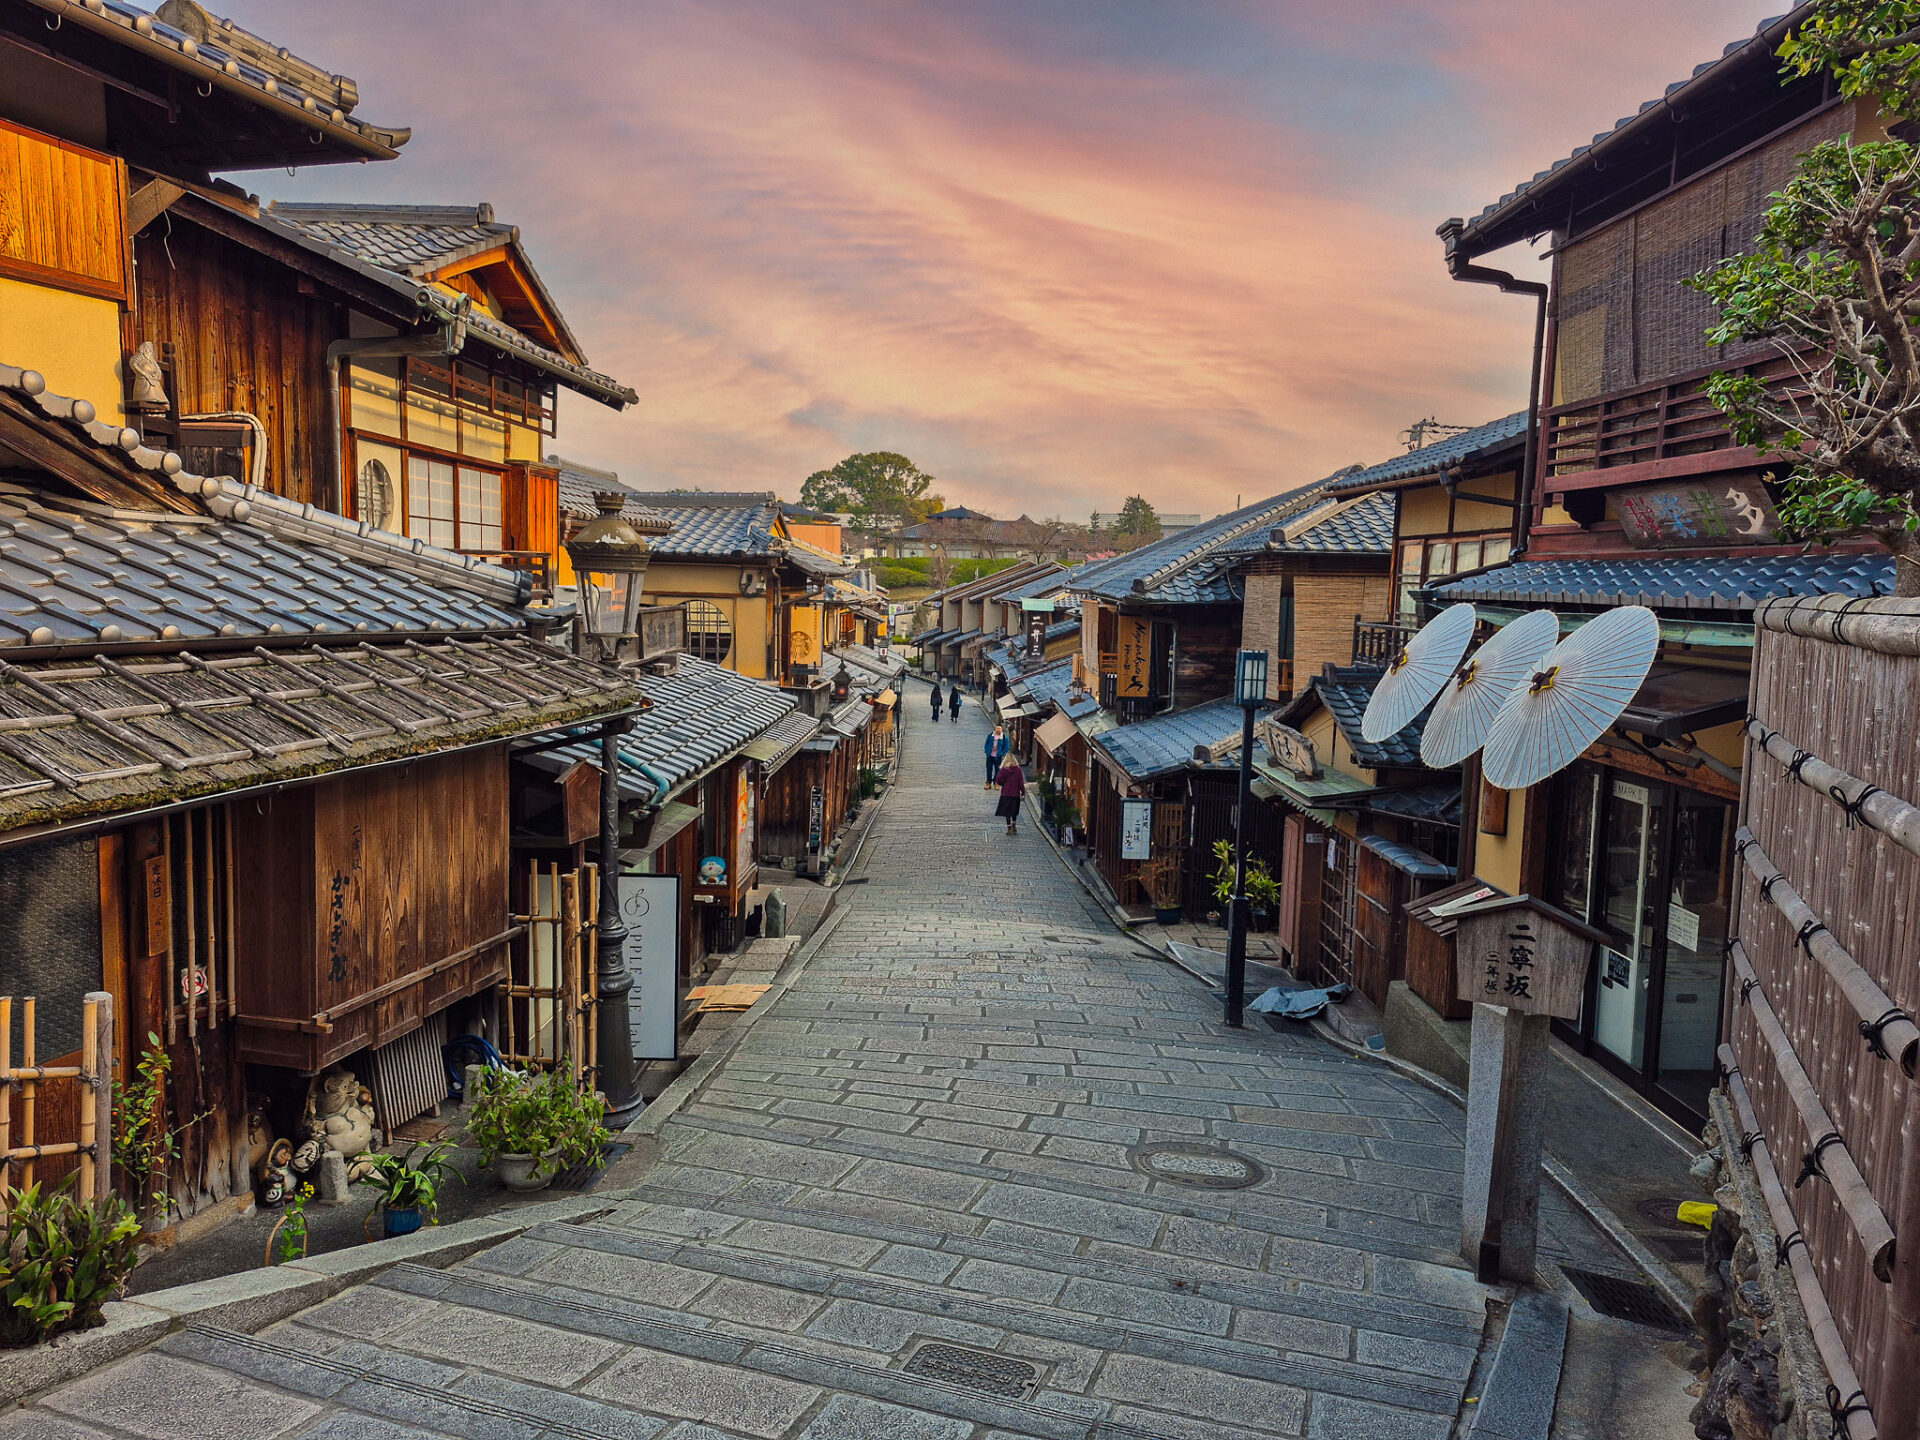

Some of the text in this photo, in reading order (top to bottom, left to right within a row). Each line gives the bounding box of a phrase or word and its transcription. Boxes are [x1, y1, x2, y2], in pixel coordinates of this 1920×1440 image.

[629, 921, 643, 1049] APPLE PIE lab
[1503, 924, 1537, 999] 二寧坂
